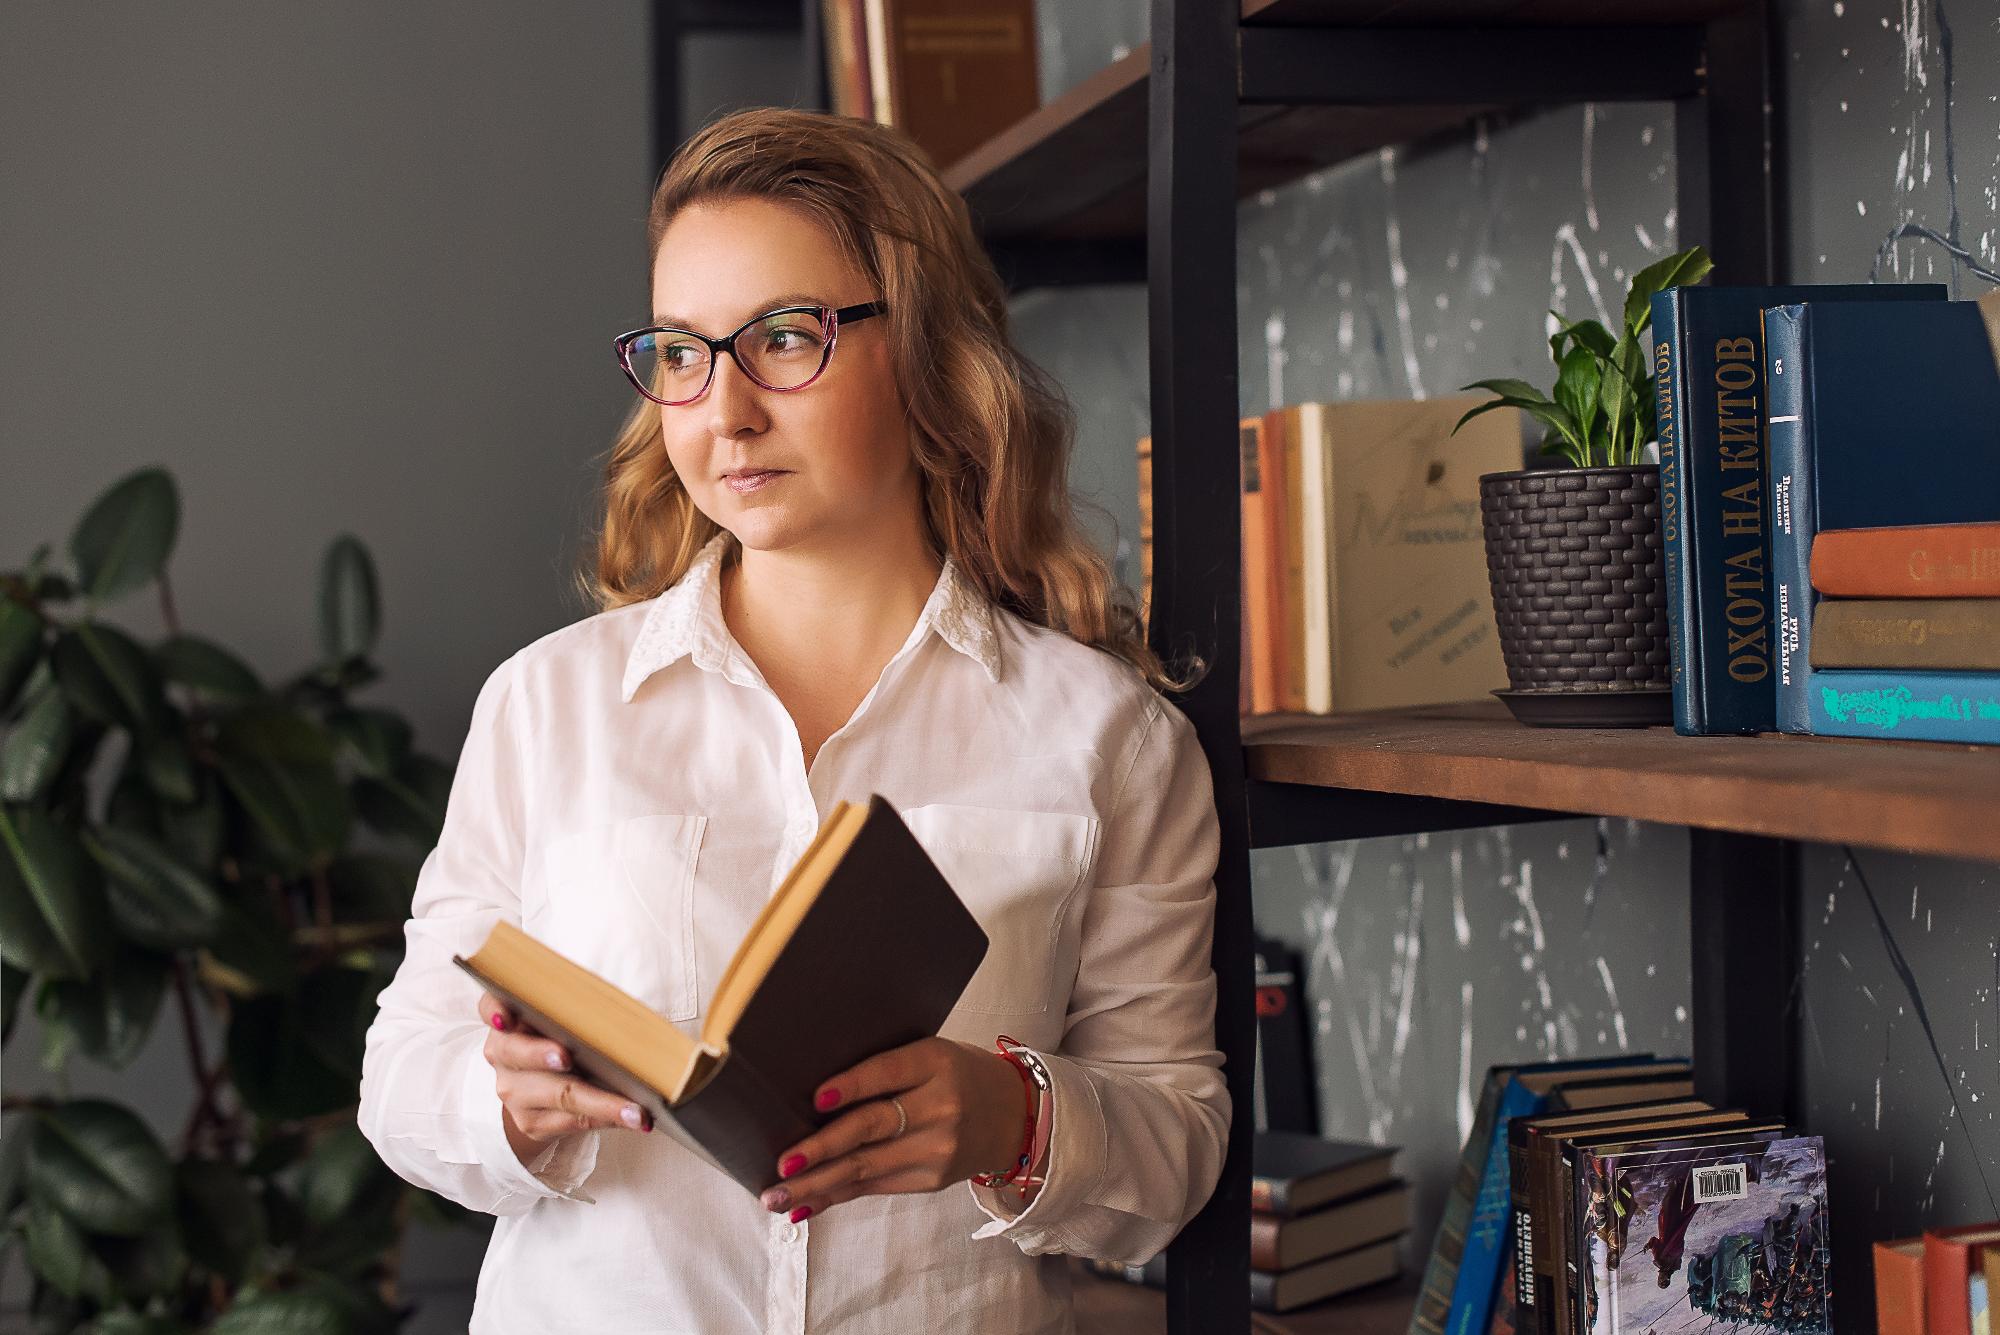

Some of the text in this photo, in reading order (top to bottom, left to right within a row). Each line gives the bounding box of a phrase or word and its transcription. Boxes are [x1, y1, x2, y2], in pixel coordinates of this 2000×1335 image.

[1656, 341, 1677, 543] ОХОТА НА КИТОВ
[1715, 336, 1768, 684] ОХОТА НА КИТОВ
[1782, 475, 1791, 535] Валентин
[1779, 583, 1790, 686] ИЗНАЧАЛЬНАЯ
[1789, 616, 1799, 652] РУСЬ
